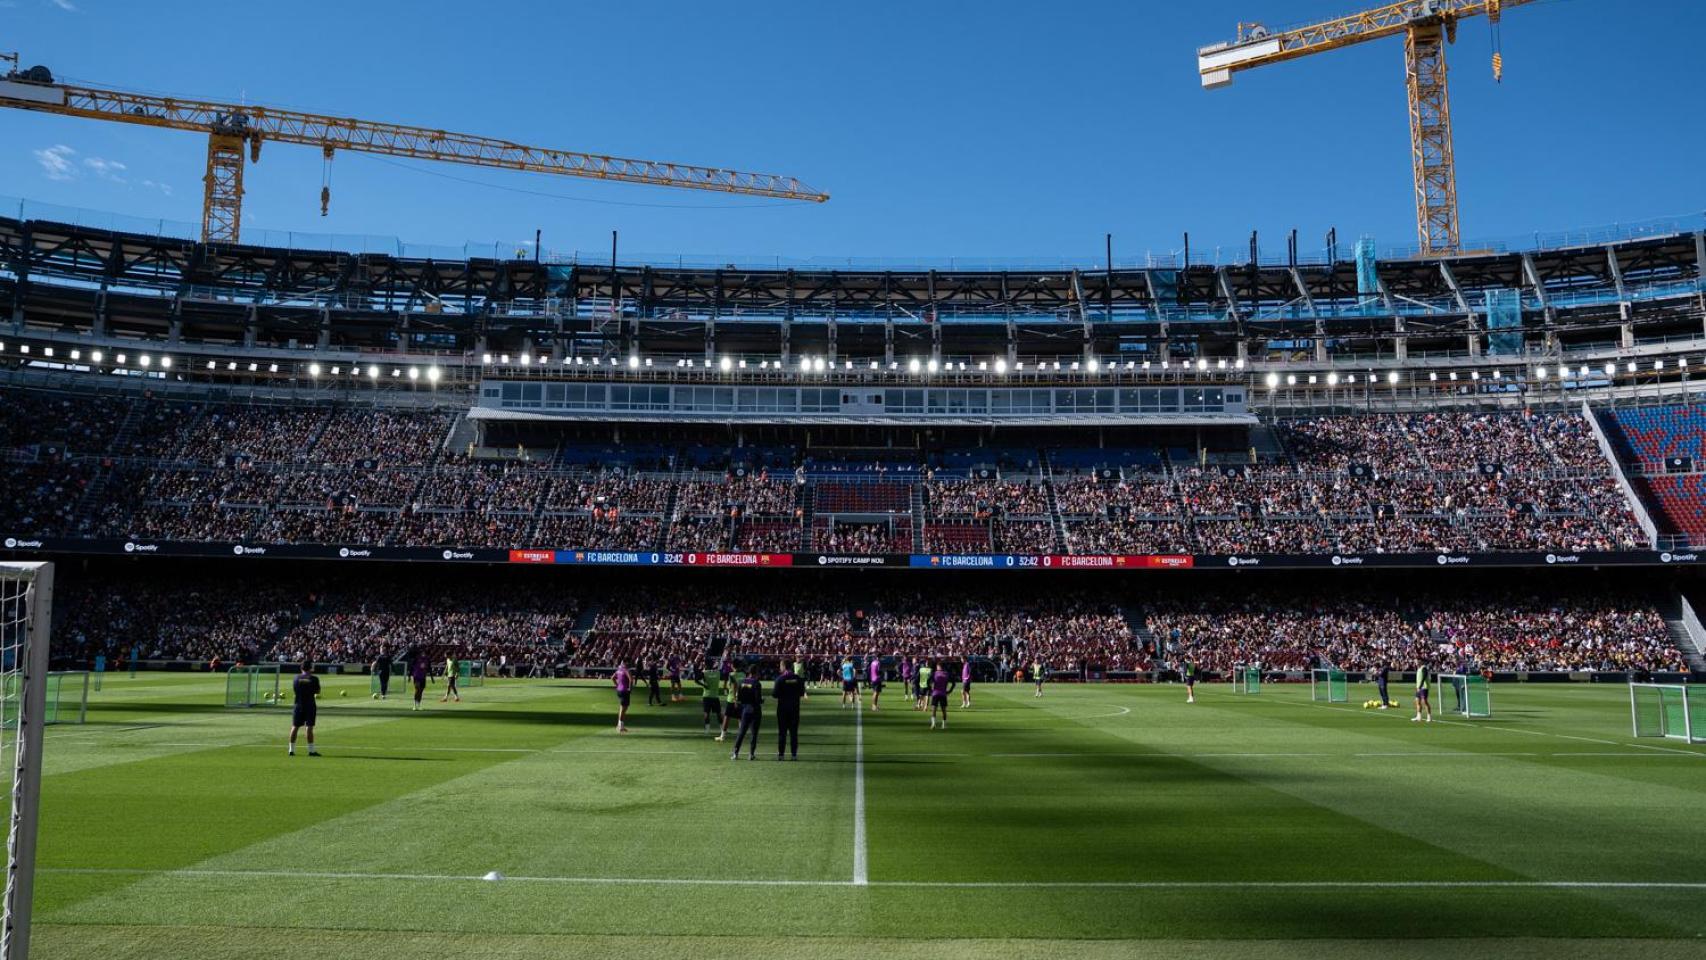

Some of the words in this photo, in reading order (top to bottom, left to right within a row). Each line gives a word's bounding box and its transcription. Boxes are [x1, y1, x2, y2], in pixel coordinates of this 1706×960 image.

[17, 540, 43, 548] Spotify
[135, 544, 159, 552] Spotify
[244, 547, 267, 555] Spotify
[349, 549, 372, 557] Spotify
[452, 552, 475, 560] Spotify
[587, 552, 597, 563] FC
[598, 552, 639, 563] BARCELONA
[651, 553, 659, 564] 0
[664, 553, 684, 564] 32:42
[688, 553, 696, 564] 0
[706, 554, 716, 564] FC
[717, 554, 758, 564] BARCELONA
[1447, 556, 1470, 564] Spotify
[1672, 554, 1698, 562] Spotify
[942, 556, 952, 566] FC
[953, 556, 994, 566] BARCELONA
[1006, 556, 1014, 567] 0
[1019, 556, 1039, 566] 32:42
[1043, 556, 1051, 567] 0
[1061, 556, 1071, 566] FC
[1072, 556, 1113, 567] BARCELONA
[1342, 557, 1364, 565] Spotify
